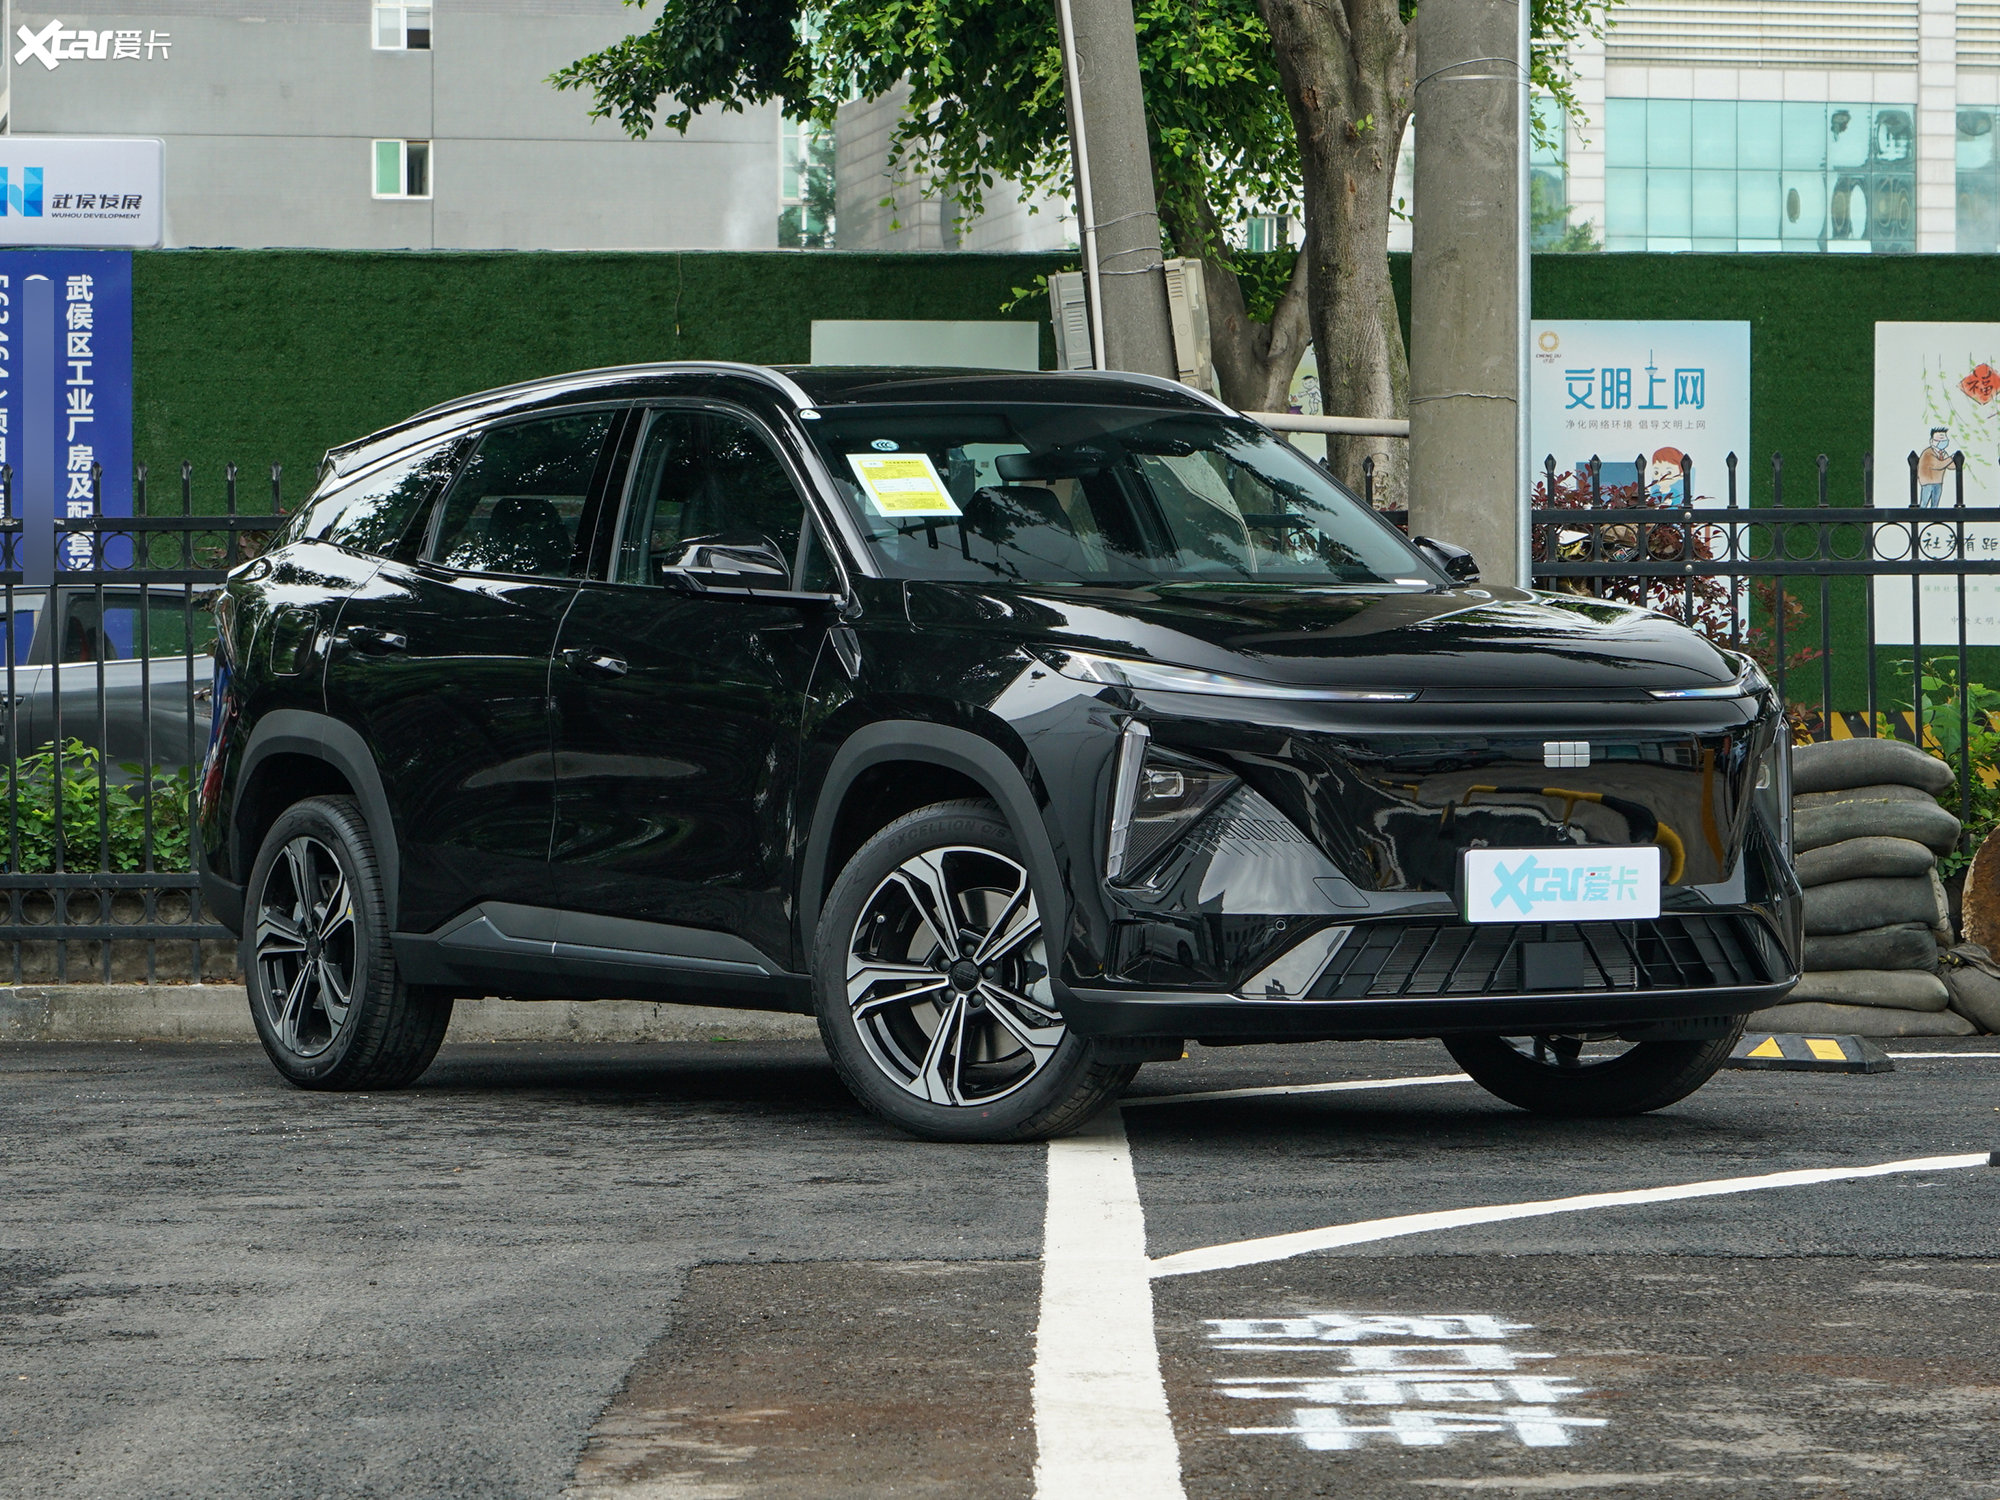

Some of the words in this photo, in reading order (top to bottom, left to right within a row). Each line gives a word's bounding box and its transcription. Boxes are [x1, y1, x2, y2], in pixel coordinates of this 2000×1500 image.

[52, 193, 142, 209] 武侯发展
[1565, 349, 1705, 410] 文明上网
[1565, 419, 1633, 431] 净化网络环境
[1638, 419, 1706, 431] 倡导文明上网
